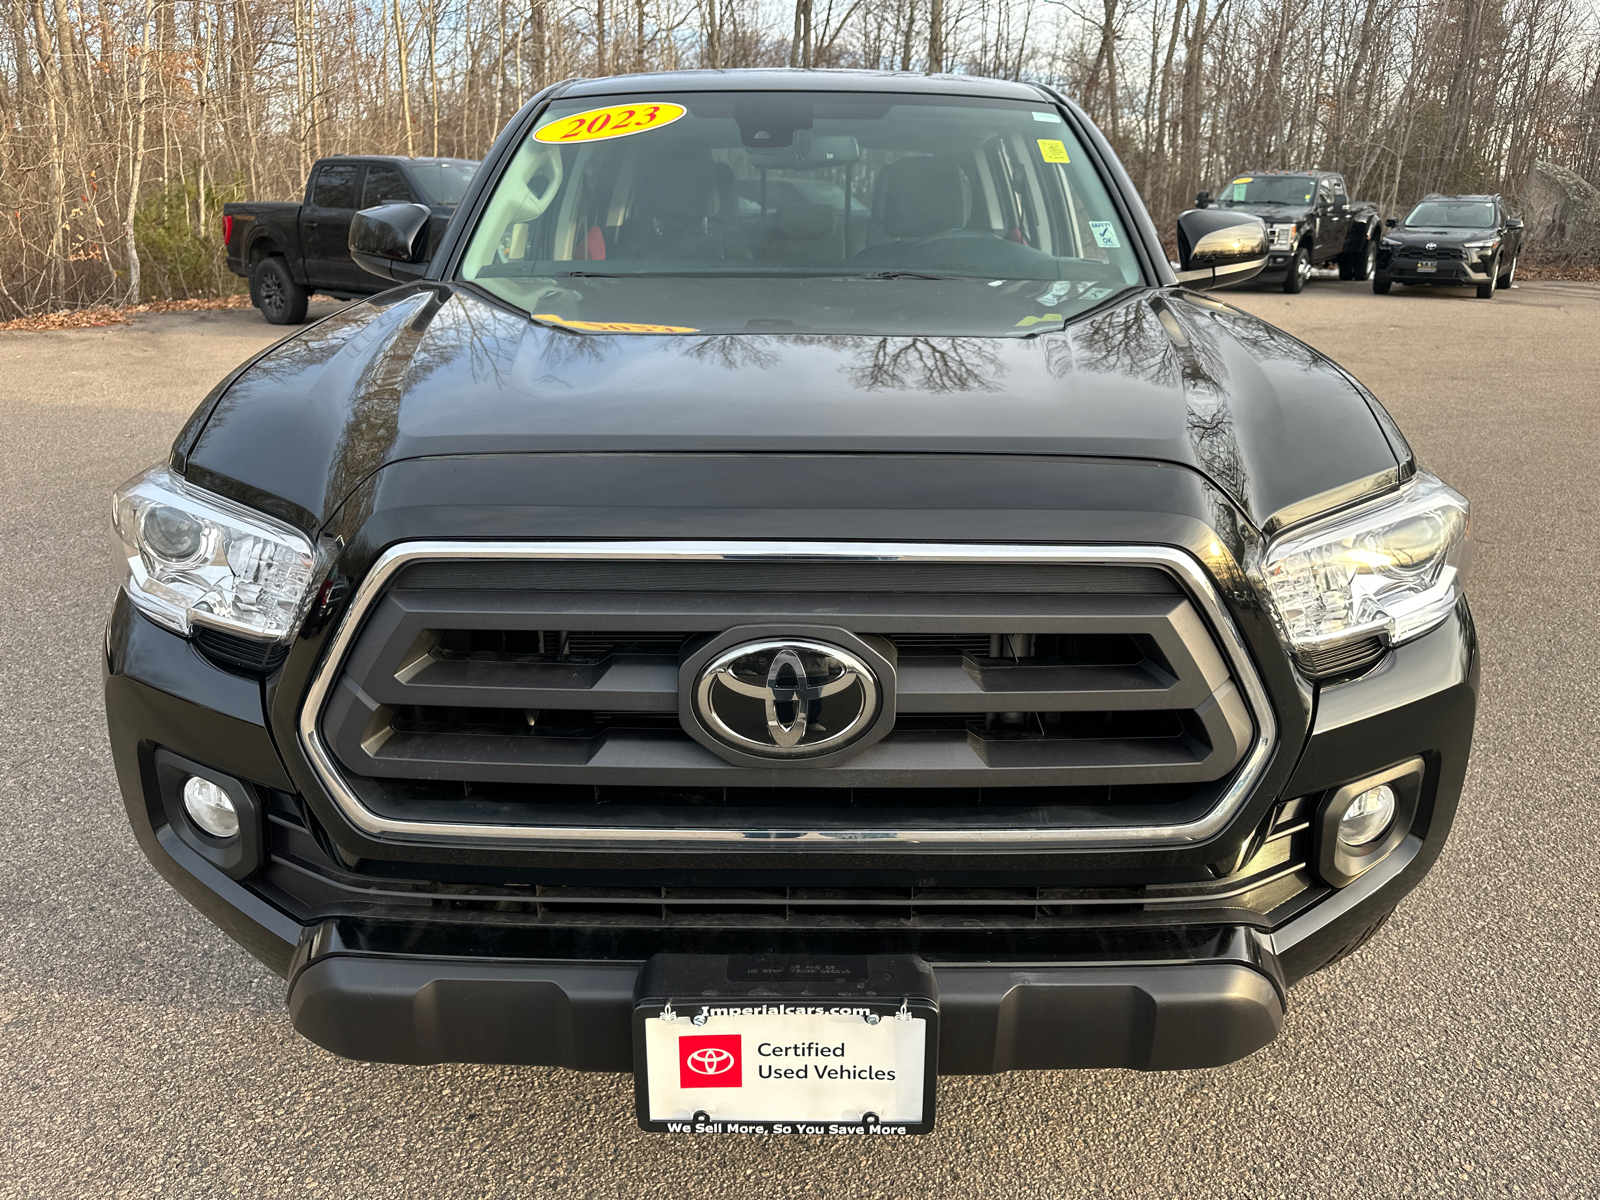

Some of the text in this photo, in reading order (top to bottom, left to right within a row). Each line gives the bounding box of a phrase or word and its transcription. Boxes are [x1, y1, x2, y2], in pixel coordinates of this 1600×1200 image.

[559, 106, 660, 139] 2023
[701, 1005, 871, 1017] Imperialcars.com
[757, 1042, 845, 1058] Certified
[758, 1065, 896, 1081] Used Vehicles
[667, 1122, 907, 1136] We Sell More, So You Save More
